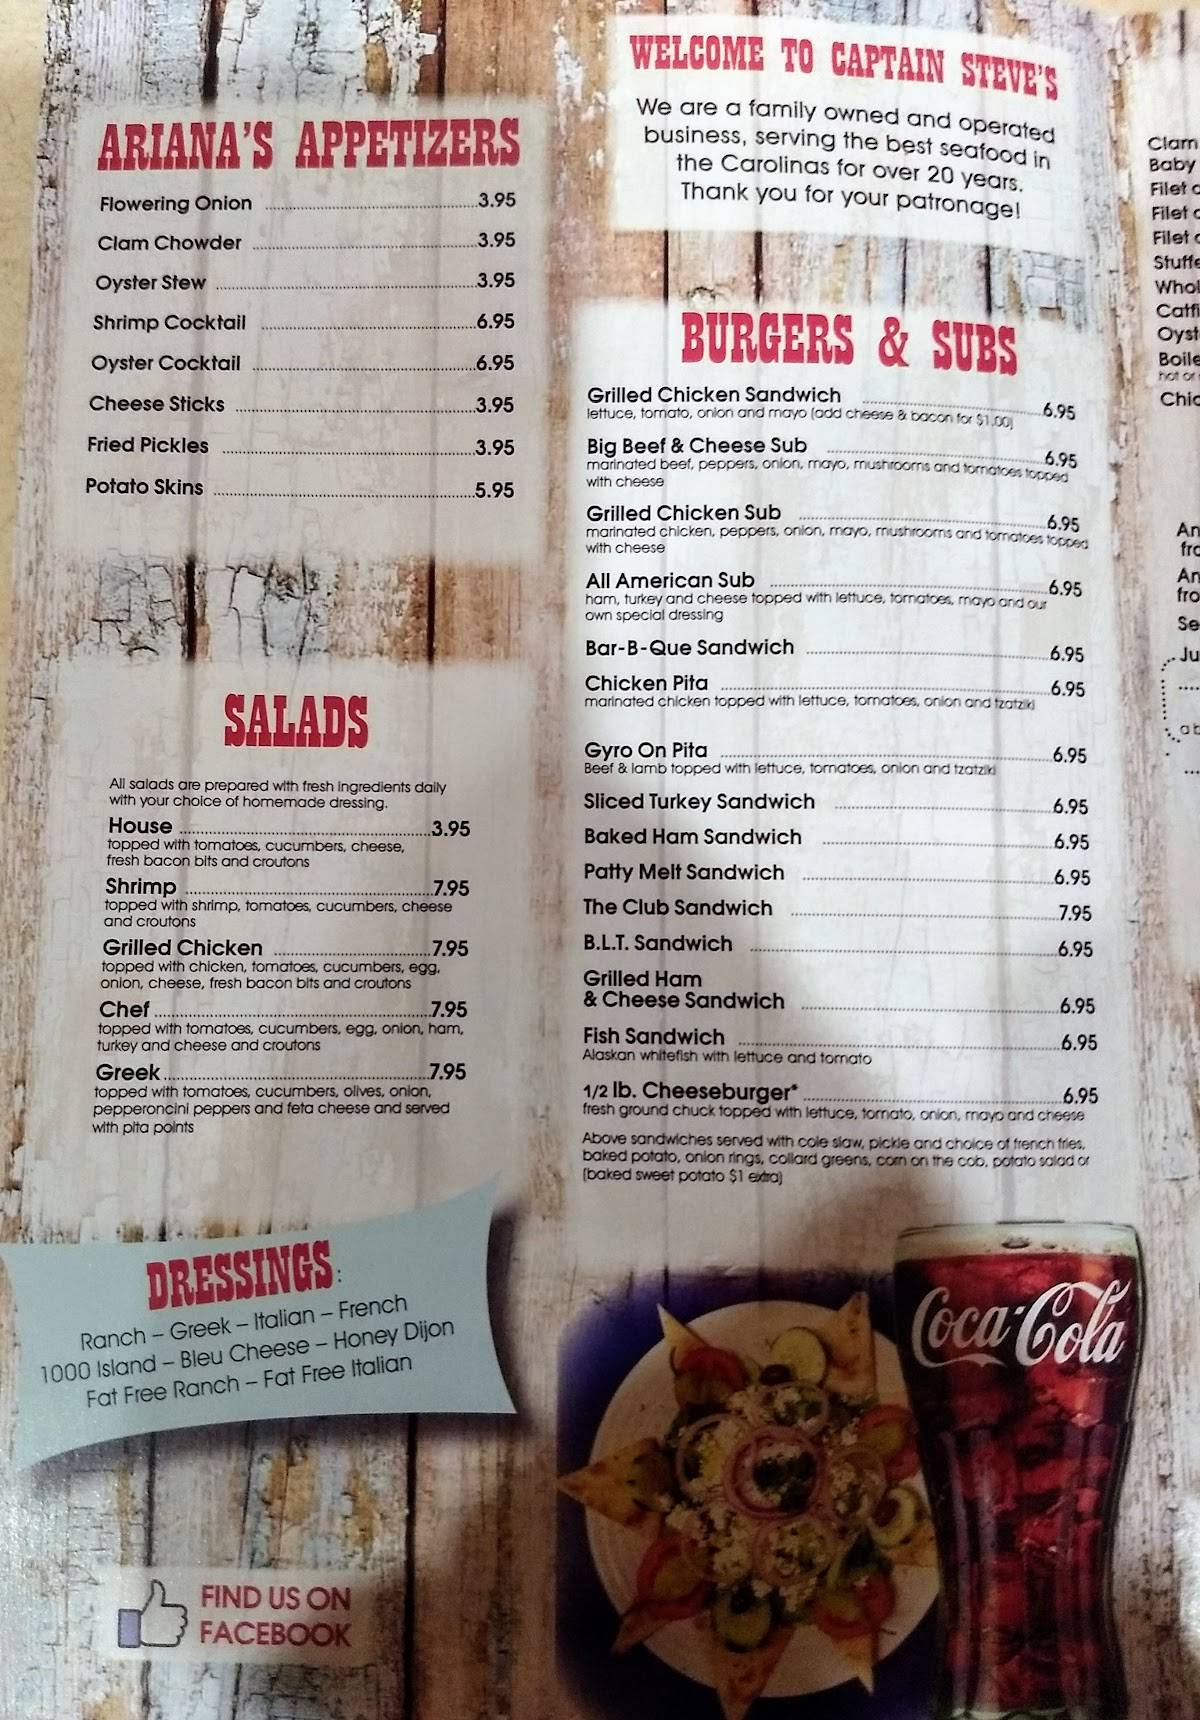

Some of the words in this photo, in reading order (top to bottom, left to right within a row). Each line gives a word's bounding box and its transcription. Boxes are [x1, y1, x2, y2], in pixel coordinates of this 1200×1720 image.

[630, 35, 764, 71] WELCOME
[781, 38, 813, 73] TO
[832, 42, 944, 83] CAPTAIN
[961, 53, 1058, 100] STEVE'S
[636, 98, 671, 115] We
[680, 102, 717, 115] are
[726, 103, 740, 116] a
[749, 99, 816, 122] family
[825, 107, 899, 125] owned
[907, 113, 950, 128] and
[959, 118, 1054, 144] operated
[97, 121, 273, 171] ARIANA'S
[295, 118, 520, 168] APPETIZERS
[645, 126, 746, 146] business,
[756, 129, 835, 152] serving
[843, 132, 878, 150] the
[887, 135, 932, 154] best
[940, 143, 1026, 165] seafood
[1034, 151, 1050, 169] in
[1148, 136, 1198, 150] Clam
[677, 154, 712, 171] the
[721, 154, 829, 175] Carolinas
[837, 159, 865, 176] for
[873, 165, 920, 181] over
[928, 165, 953, 184] 20
[961, 172, 1022, 192] years.
[1149, 158, 1196, 174] Baby
[1151, 182, 1193, 196] Filet
[101, 196, 189, 214] Flowering
[195, 196, 252, 211] Onion
[479, 192, 516, 207] 3.95
[681, 182, 748, 200] Thank
[756, 187, 796, 205] you
[805, 185, 833, 203] for
[841, 191, 888, 208] your
[897, 193, 1019, 220] patronage!
[1152, 206, 1194, 221] Filet
[98, 236, 148, 251] Clam
[155, 235, 242, 250] Chowder
[478, 232, 515, 247] 3.95
[1153, 231, 1195, 245] Filet
[96, 275, 157, 293] Oyster
[162, 275, 206, 290] Stew
[477, 272, 515, 288] 3.95
[94, 315, 159, 333] Shrimp
[164, 315, 245, 330] Cocktail
[476, 313, 514, 329] 6.95
[682, 312, 854, 365] BURGERS
[879, 317, 909, 367] &
[932, 320, 1017, 376] SUBS
[92, 355, 154, 374] Oyster
[159, 355, 240, 371] Cocktail
[476, 355, 514, 371] 6.95
[90, 396, 164, 411] Cheese
[169, 396, 224, 412] Sticks
[476, 397, 514, 413] 3.95
[588, 387, 651, 403] Grilled
[658, 387, 739, 402] Chicken
[745, 386, 840, 402] Sandwich
[1044, 402, 1075, 420] 6.95
[88, 437, 134, 452] Fried
[141, 437, 208, 453] Pickles
[475, 440, 514, 455] 3.95
[86, 478, 149, 494] Potato
[154, 479, 203, 495] Skins
[475, 482, 514, 498] 5.95
[586, 476, 611, 487] with
[616, 476, 664, 487] cheese
[586, 573, 610, 588] All
[616, 572, 712, 588] American
[718, 572, 754, 588] Sub
[1049, 580, 1082, 597] 6.95
[586, 612, 612, 621] own
[616, 609, 665, 622] special
[669, 609, 723, 623] dressing
[587, 640, 691, 656] Bar-B-Que
[697, 639, 794, 655] Sandwich
[1050, 646, 1084, 662] 6.95
[225, 694, 368, 748] SALADS
[585, 742, 632, 761] Gyro
[638, 742, 666, 758] On
[673, 742, 707, 758] Pita
[1053, 747, 1087, 763] 6.95
[109, 778, 125, 789] All
[129, 779, 174, 790] salads
[178, 781, 200, 791] are
[205, 780, 268, 793] prepared
[273, 780, 298, 792] with
[303, 781, 334, 792] fresh
[338, 781, 410, 795] ingredients
[415, 782, 446, 795] daily
[109, 817, 172, 834] House
[432, 820, 470, 837] 3.95
[107, 854, 139, 866] fresh
[144, 855, 190, 866] bacon
[195, 855, 217, 867] bits
[221, 856, 249, 867] and
[253, 856, 309, 867] croutons
[585, 863, 633, 883] Patty
[640, 864, 682, 880] Melt
[687, 864, 784, 880] Sandwich
[1055, 869, 1090, 885] 6.95
[106, 878, 176, 898] Shrimp
[432, 880, 469, 896] 7.95
[103, 939, 171, 956] Grilled
[177, 939, 262, 956] Chicken
[433, 940, 468, 956] 7.95
[100, 1001, 150, 1018] Chef
[430, 1001, 467, 1017] 7.95
[97, 1040, 138, 1054] turkey
[142, 1040, 170, 1051] and
[174, 1040, 227, 1051] cheese
[231, 1039, 259, 1051] and
[263, 1039, 320, 1051] croutons
[584, 1027, 620, 1044] Fish
[625, 1027, 724, 1045] Sandwich
[1062, 1034, 1097, 1051] 6.95
[583, 1049, 635, 1061] Alaskan
[640, 1049, 697, 1062] whitefish
[703, 1051, 729, 1061] with
[734, 1051, 783, 1063] lettuce
[788, 1052, 816, 1064] and
[820, 1052, 872, 1065] tomato
[96, 1064, 160, 1081] Greek
[430, 1063, 466, 1080] 7.95
[92, 1121, 118, 1133] with
[123, 1121, 149, 1135] pita
[154, 1121, 194, 1135] points
[81, 1328, 146, 1351] Ranch
[170, 1317, 231, 1340] Greek
[255, 1309, 315, 1330] Italian
[339, 1295, 407, 1319] French
[912, 1279, 1130, 1368] Coca-Cola
[41, 1362, 90, 1383] 1000
[97, 1354, 156, 1377] Island
[181, 1350, 223, 1368] Bleu
[229, 1340, 309, 1362] Cheese
[334, 1328, 398, 1349] Honey
[404, 1320, 454, 1342] Dijon
[87, 1388, 118, 1408] Fat
[124, 1386, 167, 1404] Free
[173, 1375, 239, 1398] Ranch
[264, 1367, 295, 1388] Fat
[302, 1365, 345, 1383] Free
[352, 1356, 412, 1377] Italian
[202, 1585, 262, 1608] FIND
[269, 1586, 300, 1610] US
[307, 1587, 350, 1610] ON
[200, 1621, 351, 1646] FACEBOOK
